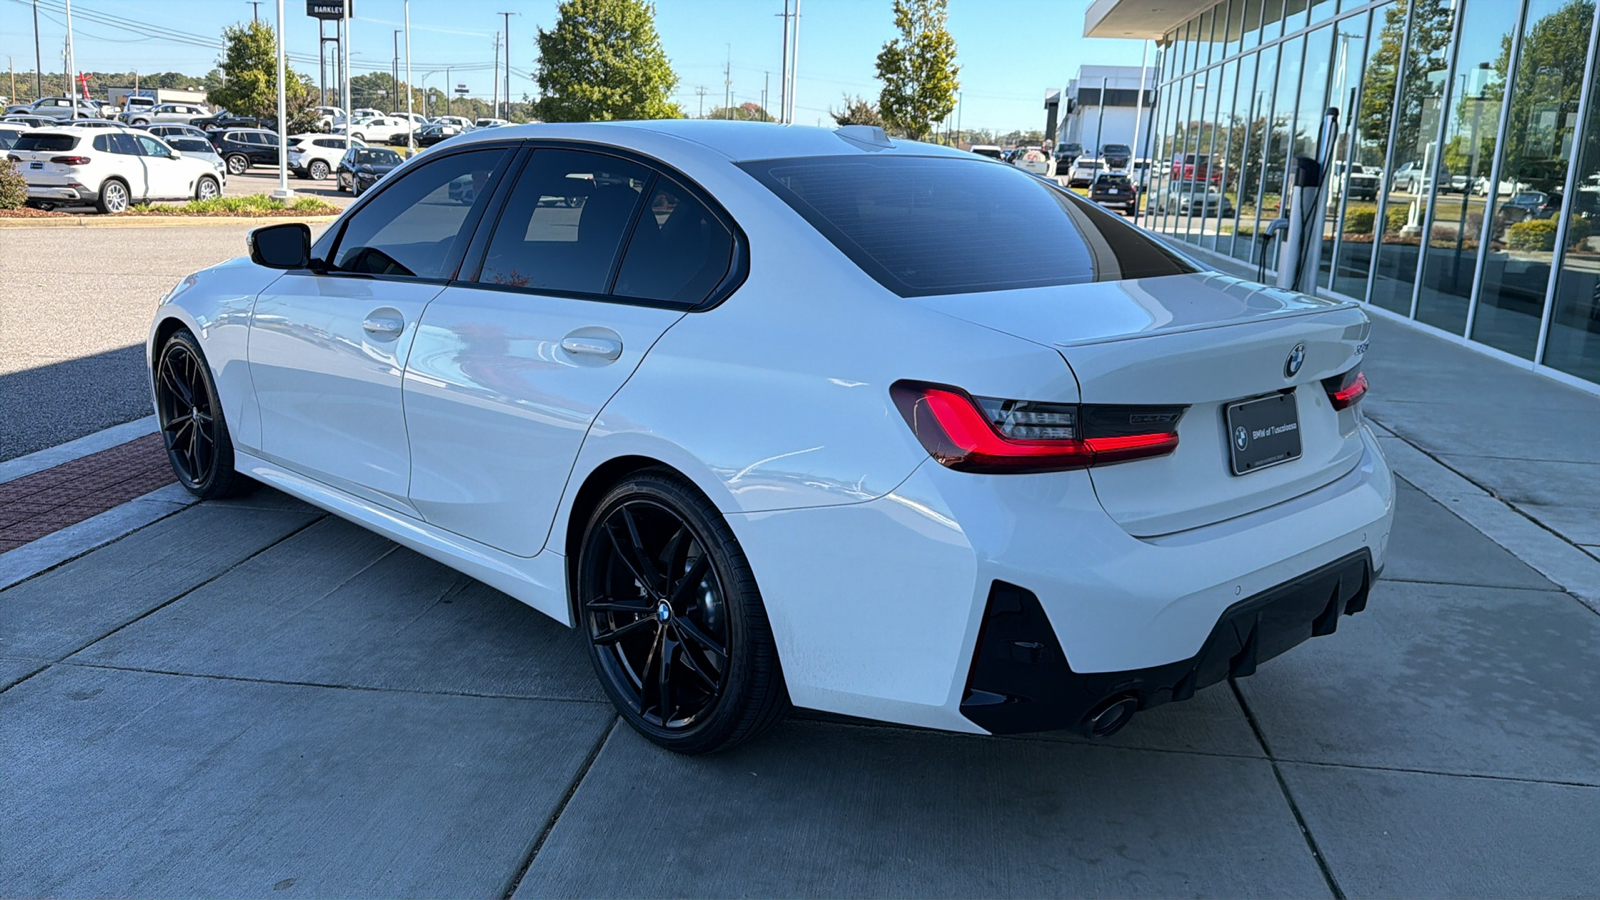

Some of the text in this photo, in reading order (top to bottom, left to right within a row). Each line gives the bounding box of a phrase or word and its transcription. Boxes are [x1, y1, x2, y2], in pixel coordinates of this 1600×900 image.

[1252, 423, 1297, 440] BMW of Tuscaloosa
